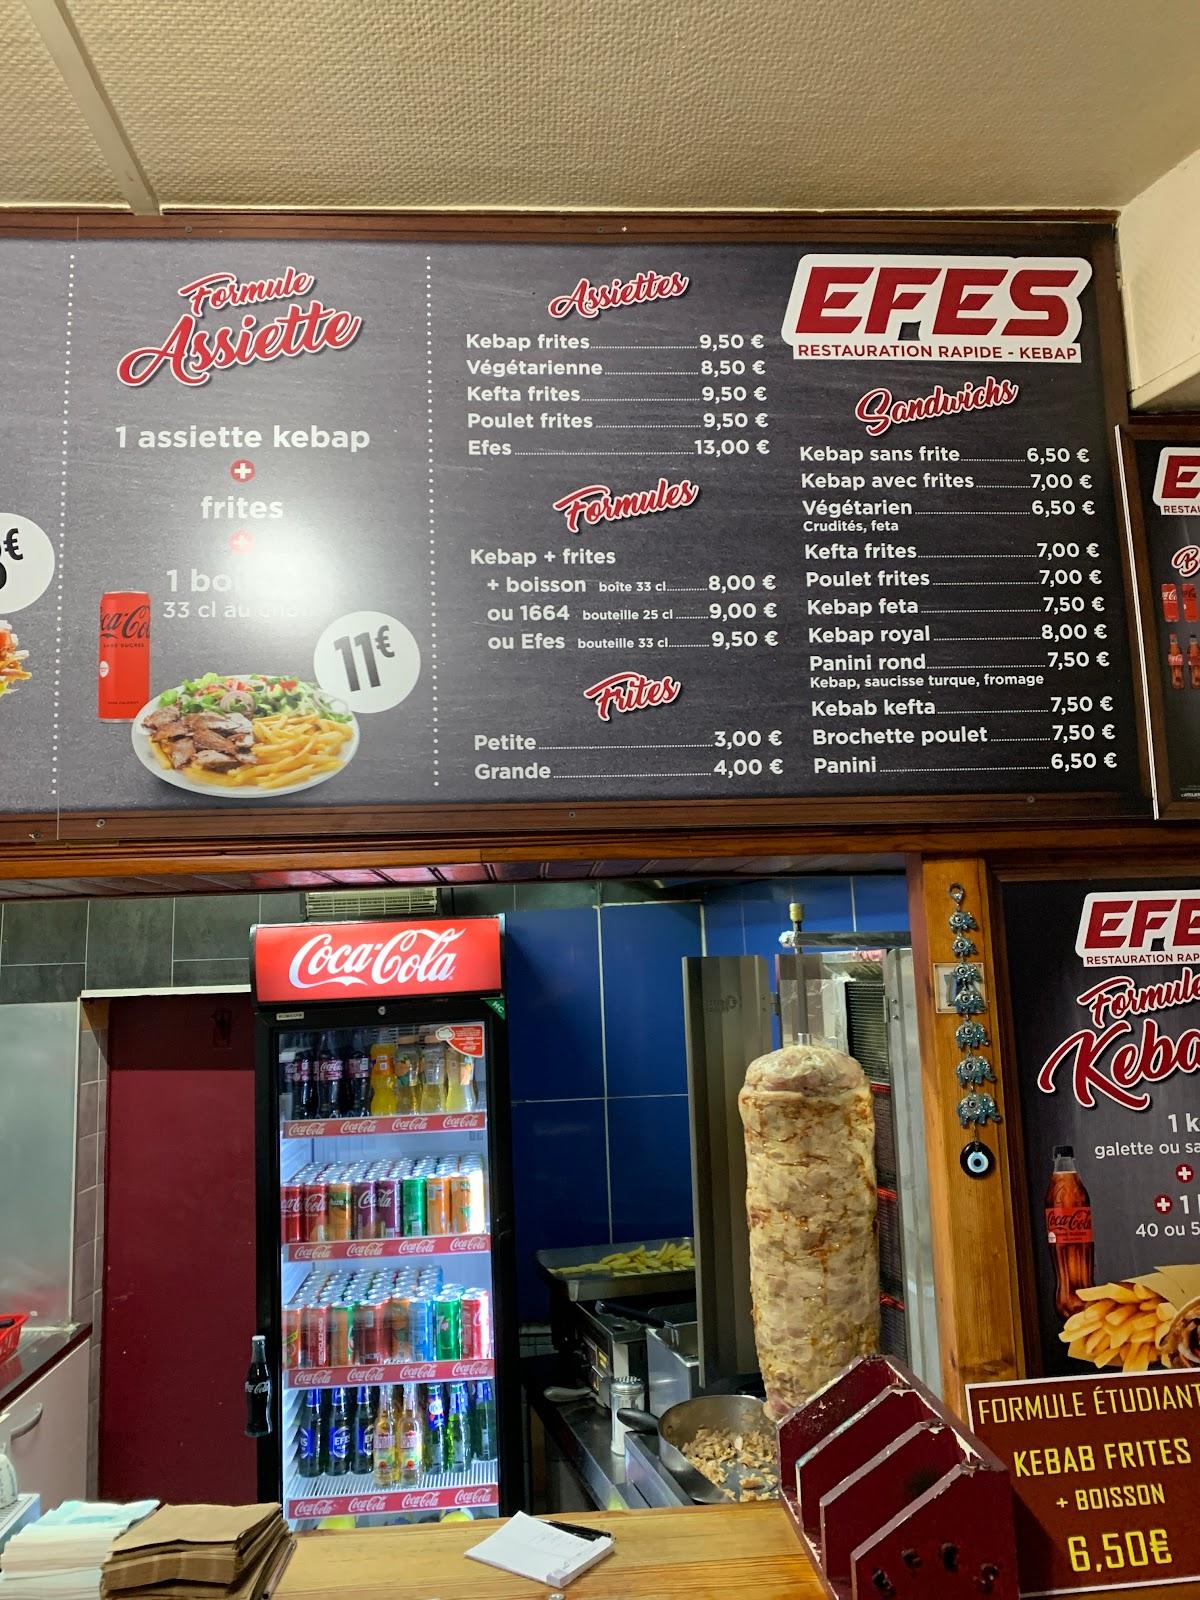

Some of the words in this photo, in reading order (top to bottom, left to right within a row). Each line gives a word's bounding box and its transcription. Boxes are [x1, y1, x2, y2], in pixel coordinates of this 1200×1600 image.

[178, 266, 315, 316] Formule
[549, 271, 690, 318] Assiettes
[795, 267, 1079, 337] EFES
[116, 300, 362, 387] Assiette
[467, 334, 531, 351] Kebap
[538, 334, 589, 348] frites
[700, 334, 743, 351] 9,50
[751, 334, 764, 348] €
[798, 345, 933, 357] RESTAURATION
[939, 346, 1002, 358] RAPIDE
[1020, 348, 1077, 360] KEBAP
[466, 359, 602, 377] Végétarienne
[702, 360, 745, 377] 8,50
[752, 360, 765, 374] €
[468, 386, 521, 401] Kefta
[528, 386, 580, 401] frites
[702, 387, 746, 404] 9,50
[754, 387, 767, 401] €
[855, 376, 1019, 437] Sandwichs
[468, 413, 533, 428] Poulet
[540, 413, 593, 428] frites
[704, 413, 748, 430] 9,50
[755, 413, 768, 427] €
[116, 426, 126, 447] 1
[139, 425, 262, 448] assiette
[274, 425, 369, 452] kebap
[469, 440, 511, 455] Efes
[695, 440, 749, 457] 13,00
[756, 440, 769, 454] €
[800, 446, 863, 464] Kebap
[870, 450, 913, 461] sans
[919, 446, 959, 461] frite
[1027, 448, 1070, 464] 6,50
[1077, 449, 1089, 462] €
[802, 473, 865, 490] Kebap
[872, 476, 917, 487] avec
[923, 473, 974, 487] frites
[1031, 474, 1072, 491] 7,00
[1079, 475, 1092, 488] €
[202, 496, 286, 522] frites
[553, 478, 699, 533] Formules
[802, 499, 912, 518] Végétarien
[1032, 500, 1075, 517] 6,50
[1082, 501, 1095, 515] €
[803, 520, 866, 533] Crudités,
[871, 520, 898, 531] feta
[471, 549, 536, 567] Kebap
[544, 551, 555, 562] +
[563, 548, 615, 564] frites
[805, 544, 858, 559] Kefta
[865, 543, 916, 558] frites
[1037, 543, 1079, 560] 7,00
[1086, 543, 1099, 557] €
[167, 570, 177, 592] 1
[488, 579, 499, 590] +
[507, 577, 586, 592] boisson
[599, 581, 632, 592] boîte
[637, 582, 651, 591] 33
[655, 581, 666, 591] cl
[709, 575, 755, 593] 8,00
[762, 575, 776, 590] €
[807, 571, 871, 587] Poulet
[878, 570, 930, 586] frites
[1039, 570, 1082, 587] 7,00
[1089, 570, 1102, 584] €
[163, 602, 190, 618] 33
[199, 601, 216, 617] cl
[224, 602, 253, 620] au
[488, 609, 513, 621] ou
[520, 605, 569, 620] 1664
[583, 610, 639, 620] bouteille
[643, 610, 658, 619] 25
[662, 609, 672, 619] cl
[710, 603, 756, 621] 9,00
[764, 603, 777, 618] €
[808, 599, 872, 617] Kebap
[879, 598, 918, 613] feta
[1043, 597, 1084, 615] 7,50
[1092, 597, 1104, 611] €
[488, 637, 513, 649] ou
[522, 633, 565, 649] Efes
[578, 638, 634, 648] bouteille
[639, 638, 653, 648] 33
[658, 637, 668, 647] cl
[712, 631, 757, 649] 9,50
[765, 631, 778, 646] €
[809, 627, 873, 645] Kebap
[881, 625, 930, 644] royal
[1042, 624, 1087, 642] 8,00
[1094, 624, 1107, 639] €
[333, 625, 396, 692] 11€
[810, 655, 871, 671] Panini
[879, 654, 925, 670] rond
[1048, 652, 1089, 670] 7,50
[1096, 652, 1109, 666] €
[811, 677, 860, 689] Kebap,
[865, 675, 924, 687] saucisse
[928, 675, 979, 687] turque,
[984, 674, 1044, 686] fromage
[584, 671, 681, 721] Frites
[812, 700, 877, 716] Kebab
[884, 699, 935, 715] kefta
[1051, 696, 1092, 715] 7,50
[1100, 696, 1113, 711] €
[475, 734, 536, 750] Petite
[715, 731, 761, 749] 3,00
[768, 730, 782, 746] €
[813, 728, 914, 745] Brochette
[922, 726, 987, 746] poulet
[1053, 725, 1094, 743] 7,50
[1102, 724, 1115, 739] €
[475, 762, 551, 779] Grande
[714, 759, 762, 778] 4,00
[770, 759, 783, 774] €
[814, 757, 876, 773] Panini
[1051, 753, 1096, 772] 6,50
[1104, 752, 1117, 768] €
[289, 928, 466, 989] Coca-Cola
[1087, 954, 1174, 964] RESTAURATION
[1168, 1114, 1178, 1130] 1
[1095, 1142, 1154, 1159] galette
[1159, 1144, 1179, 1153] ou
[1136, 1223, 1158, 1237] 40
[1164, 1225, 1185, 1235] ou
[978, 1391, 1086, 1424] FORMULE
[1014, 1445, 1096, 1478] KEBAB
[1104, 1438, 1192, 1470] FRITES
[1056, 1498, 1068, 1508] +
[1075, 1483, 1166, 1511] BOISSON
[1068, 1529, 1173, 1572] 6,50€
